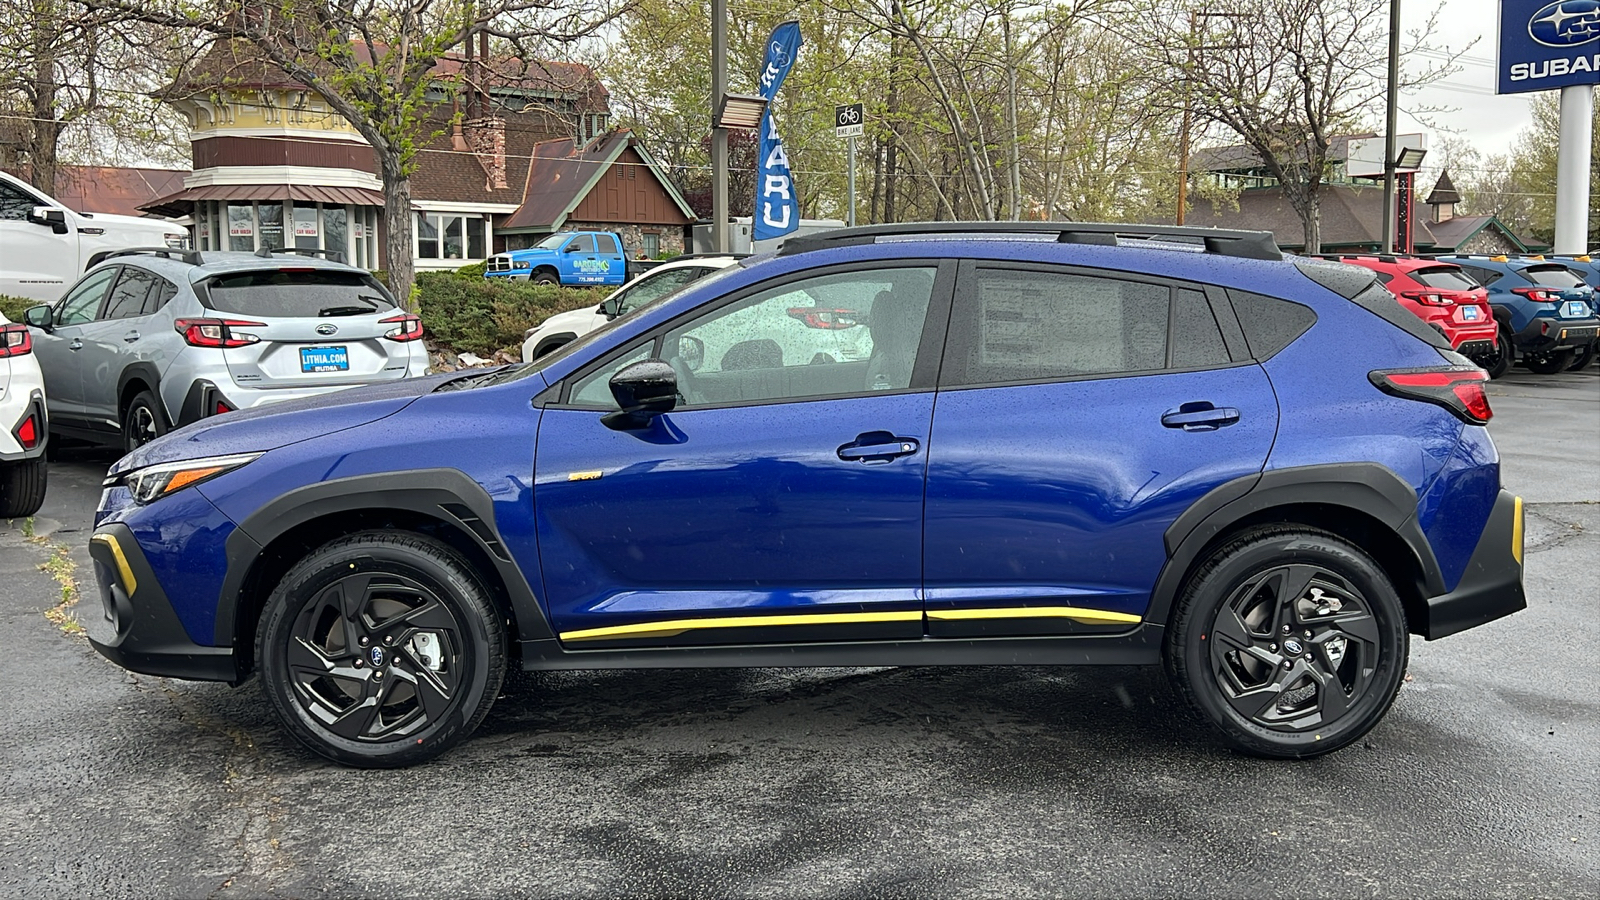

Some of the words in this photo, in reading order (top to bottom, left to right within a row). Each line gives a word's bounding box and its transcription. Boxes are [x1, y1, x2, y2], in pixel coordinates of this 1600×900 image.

[837, 127, 848, 136] BIKE
[850, 126, 862, 134] LANE
[761, 62, 791, 229] SARU
[573, 260, 601, 269] GARDEN
[302, 353, 347, 365] LITHIA.COM
